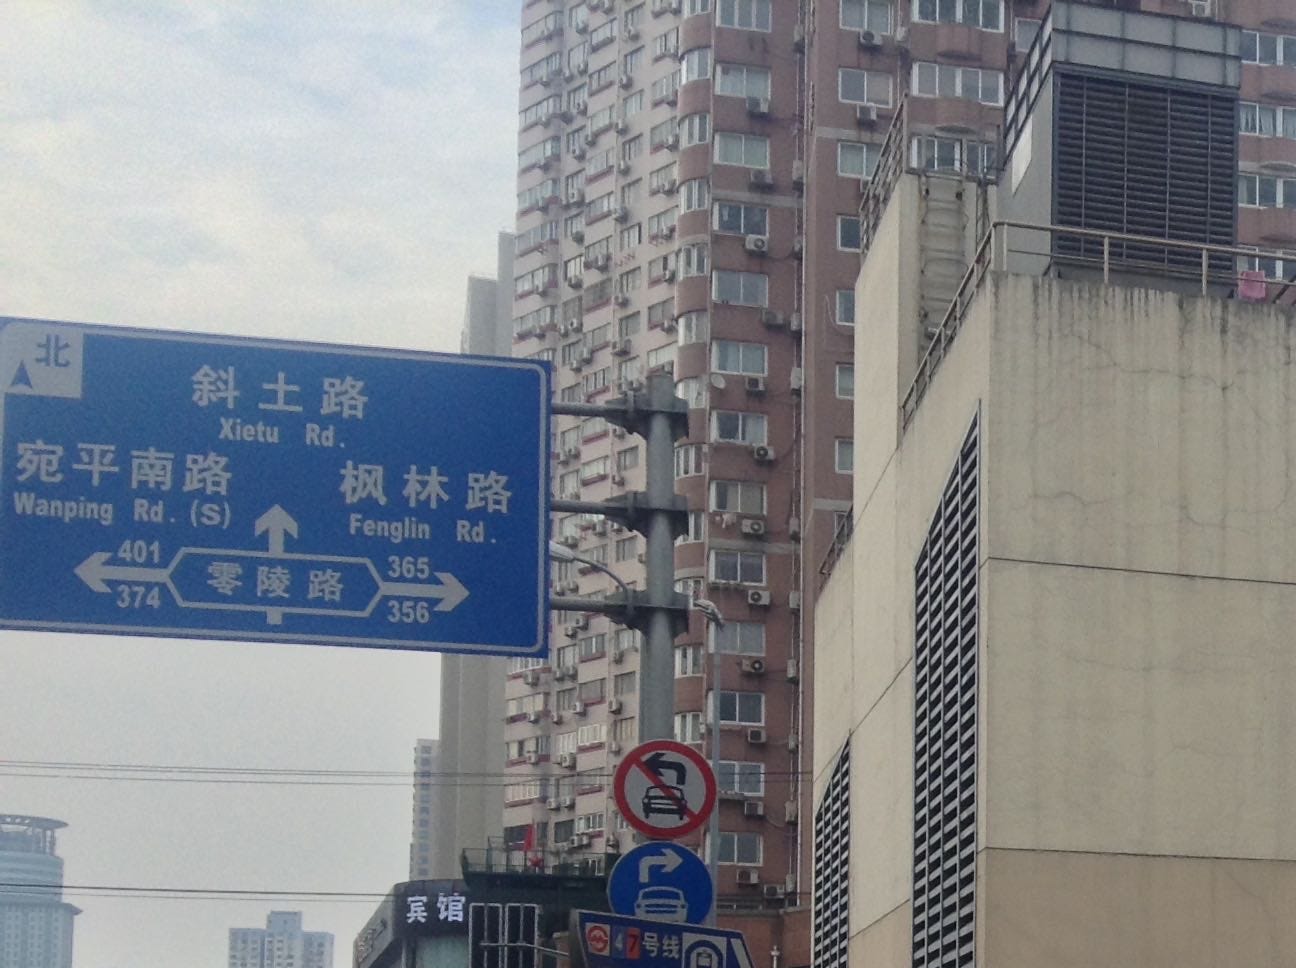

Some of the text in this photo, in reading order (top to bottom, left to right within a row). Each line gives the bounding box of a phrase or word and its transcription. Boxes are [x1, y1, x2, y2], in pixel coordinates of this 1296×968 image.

[35, 333, 71, 368] 北
[191, 365, 368, 419] 斜土路
[218, 417, 345, 448] Xietu Rd.
[16, 440, 233, 496] 宛平南路
[339, 460, 512, 514] 枫林路
[14, 491, 231, 529] Wanping Rd. (S)
[349, 514, 497, 543] Fenglin Rd.
[117, 540, 160, 563] 401
[387, 556, 430, 578] 365
[116, 584, 160, 608] 374
[206, 562, 344, 601] 零陵路
[387, 600, 430, 623] 356
[405, 892, 466, 923] 宾馆
